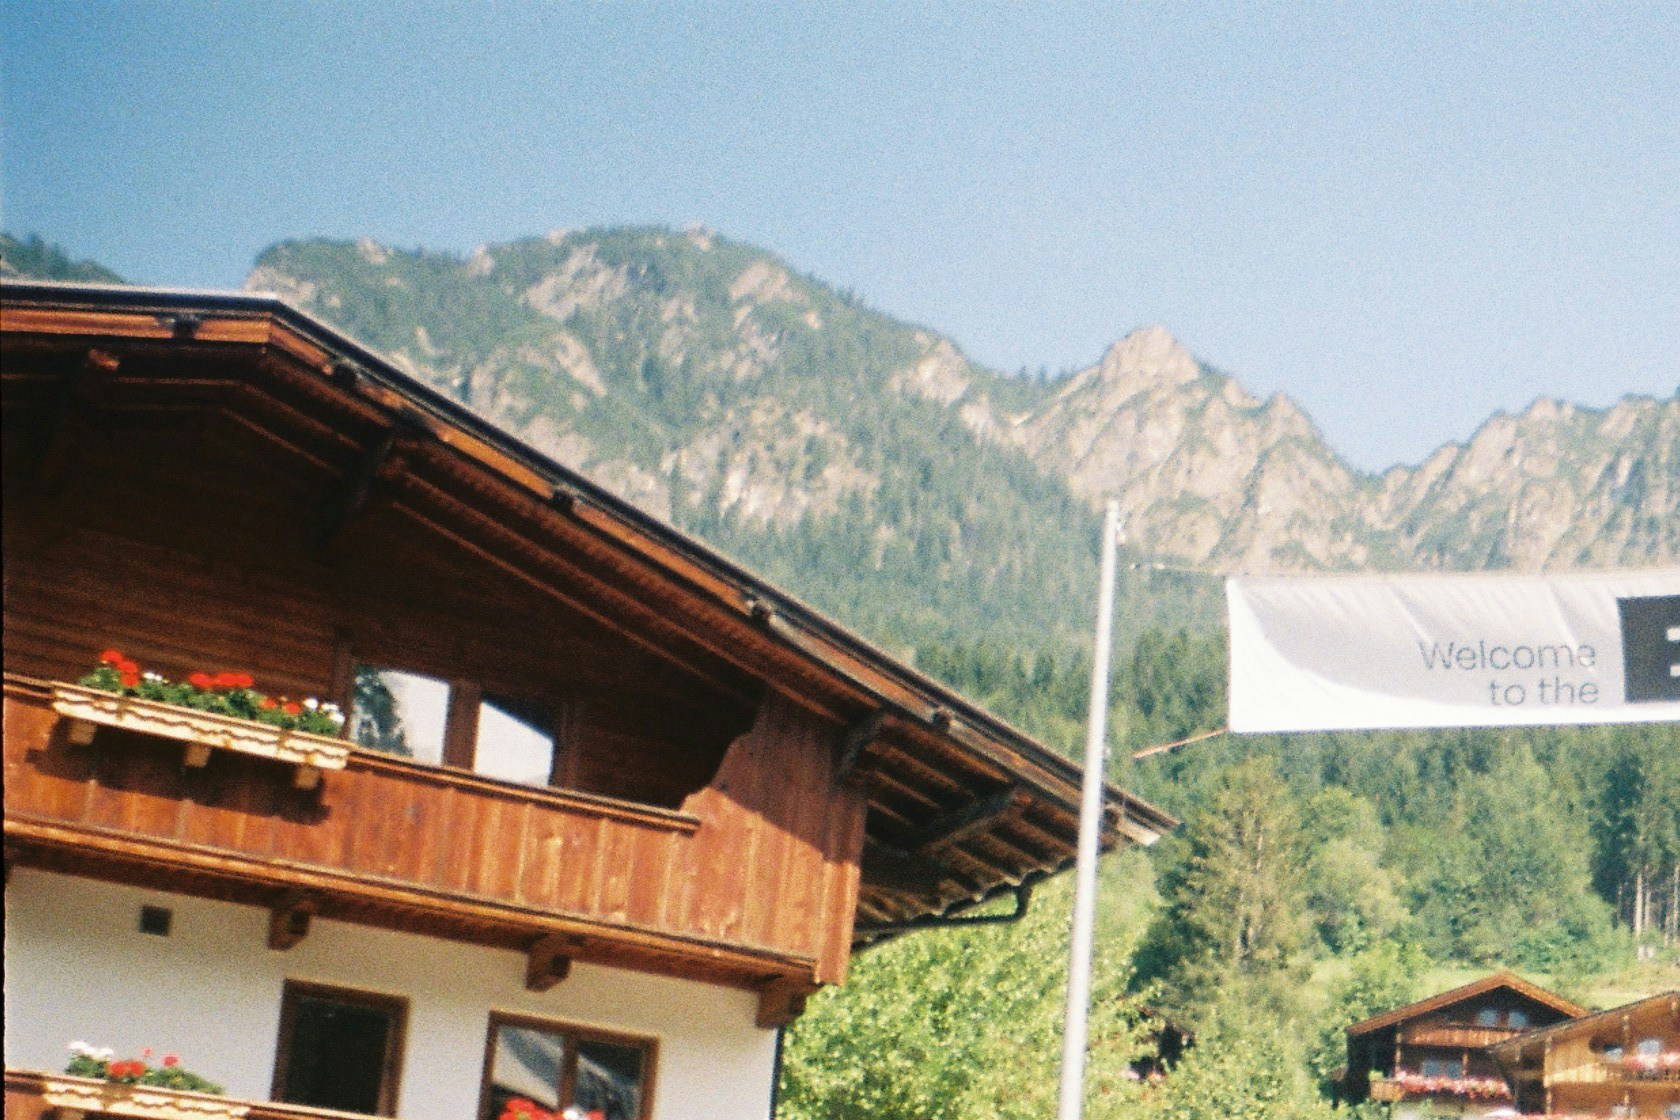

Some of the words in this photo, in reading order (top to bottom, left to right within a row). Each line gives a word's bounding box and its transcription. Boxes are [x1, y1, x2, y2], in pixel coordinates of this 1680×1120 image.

[1418, 640, 1596, 671] Welcome
[1489, 679, 1527, 706] to
[1538, 676, 1600, 705] the
